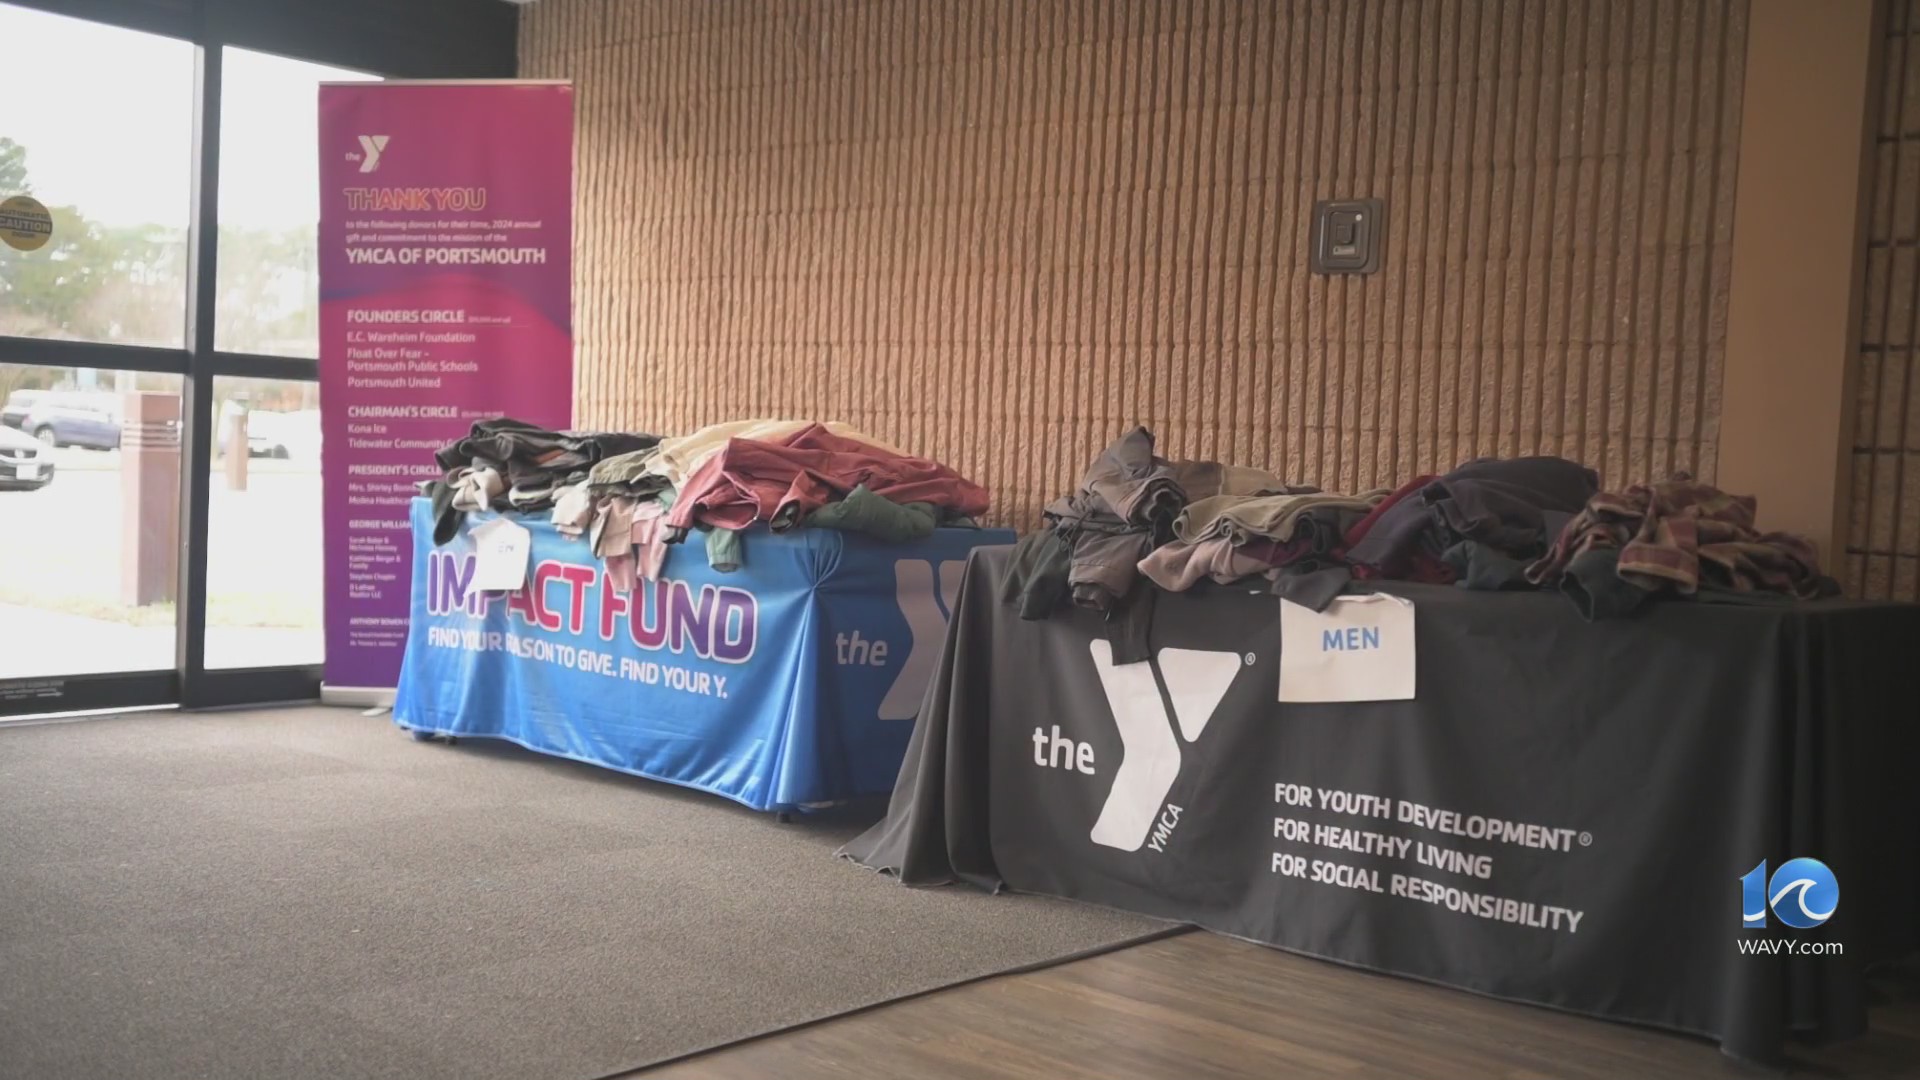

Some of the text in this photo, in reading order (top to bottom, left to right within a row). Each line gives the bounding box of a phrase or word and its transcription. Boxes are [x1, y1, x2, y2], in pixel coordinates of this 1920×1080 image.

[345, 151, 360, 162] the
[343, 187, 487, 211] THANK YOU
[345, 220, 355, 229] to
[355, 220, 369, 229] the
[370, 220, 407, 231] following
[408, 221, 436, 229] donors
[437, 220, 449, 229] for
[450, 220, 468, 229] their
[492, 220, 513, 229] 2024
[514, 220, 541, 229] annual
[345, 233, 507, 243] gift and commitment to the mission of the
[345, 247, 546, 265] YMCA OF PORTSMOUTH
[347, 309, 419, 324] FOUNDERS
[421, 309, 465, 324] CIRCLE
[347, 331, 366, 343] E.C.
[419, 331, 476, 343] Foundation
[347, 347, 372, 359] Float
[374, 347, 398, 359] Over
[400, 347, 422, 359] Fear
[347, 360, 478, 372] Portsmouth Public Schools
[347, 377, 441, 389] Portsmouth United
[348, 406, 418, 418] CHAIRMAN'S
[420, 406, 458, 418] CIRCLE
[348, 424, 387, 435] Kona Ice
[348, 438, 393, 449] Tidewater
[394, 438, 445, 451] Community
[348, 464, 409, 475] PRESIDENT'S
[366, 483, 392, 494] Shirley
[348, 519, 380, 529] GEORGE
[599, 569, 758, 664] FUND
[1322, 626, 1379, 652] MEN
[835, 630, 888, 666] the
[428, 625, 460, 649] FIND
[460, 630, 503, 652] YOUR
[555, 643, 575, 668] TO
[577, 649, 617, 677] GIVE.
[620, 657, 659, 685] FIND
[662, 665, 711, 696] YOUR
[713, 674, 728, 699] Y.
[1032, 724, 1096, 775] the
[1274, 782, 1313, 808] FOR
[1317, 788, 1391, 819] YOUTH
[1147, 802, 1184, 853] YMCA
[1273, 817, 1493, 880] FOR HEALTHY LIVING
[1271, 852, 1585, 934] FOR SOCIAL RESPONSIBILITY
